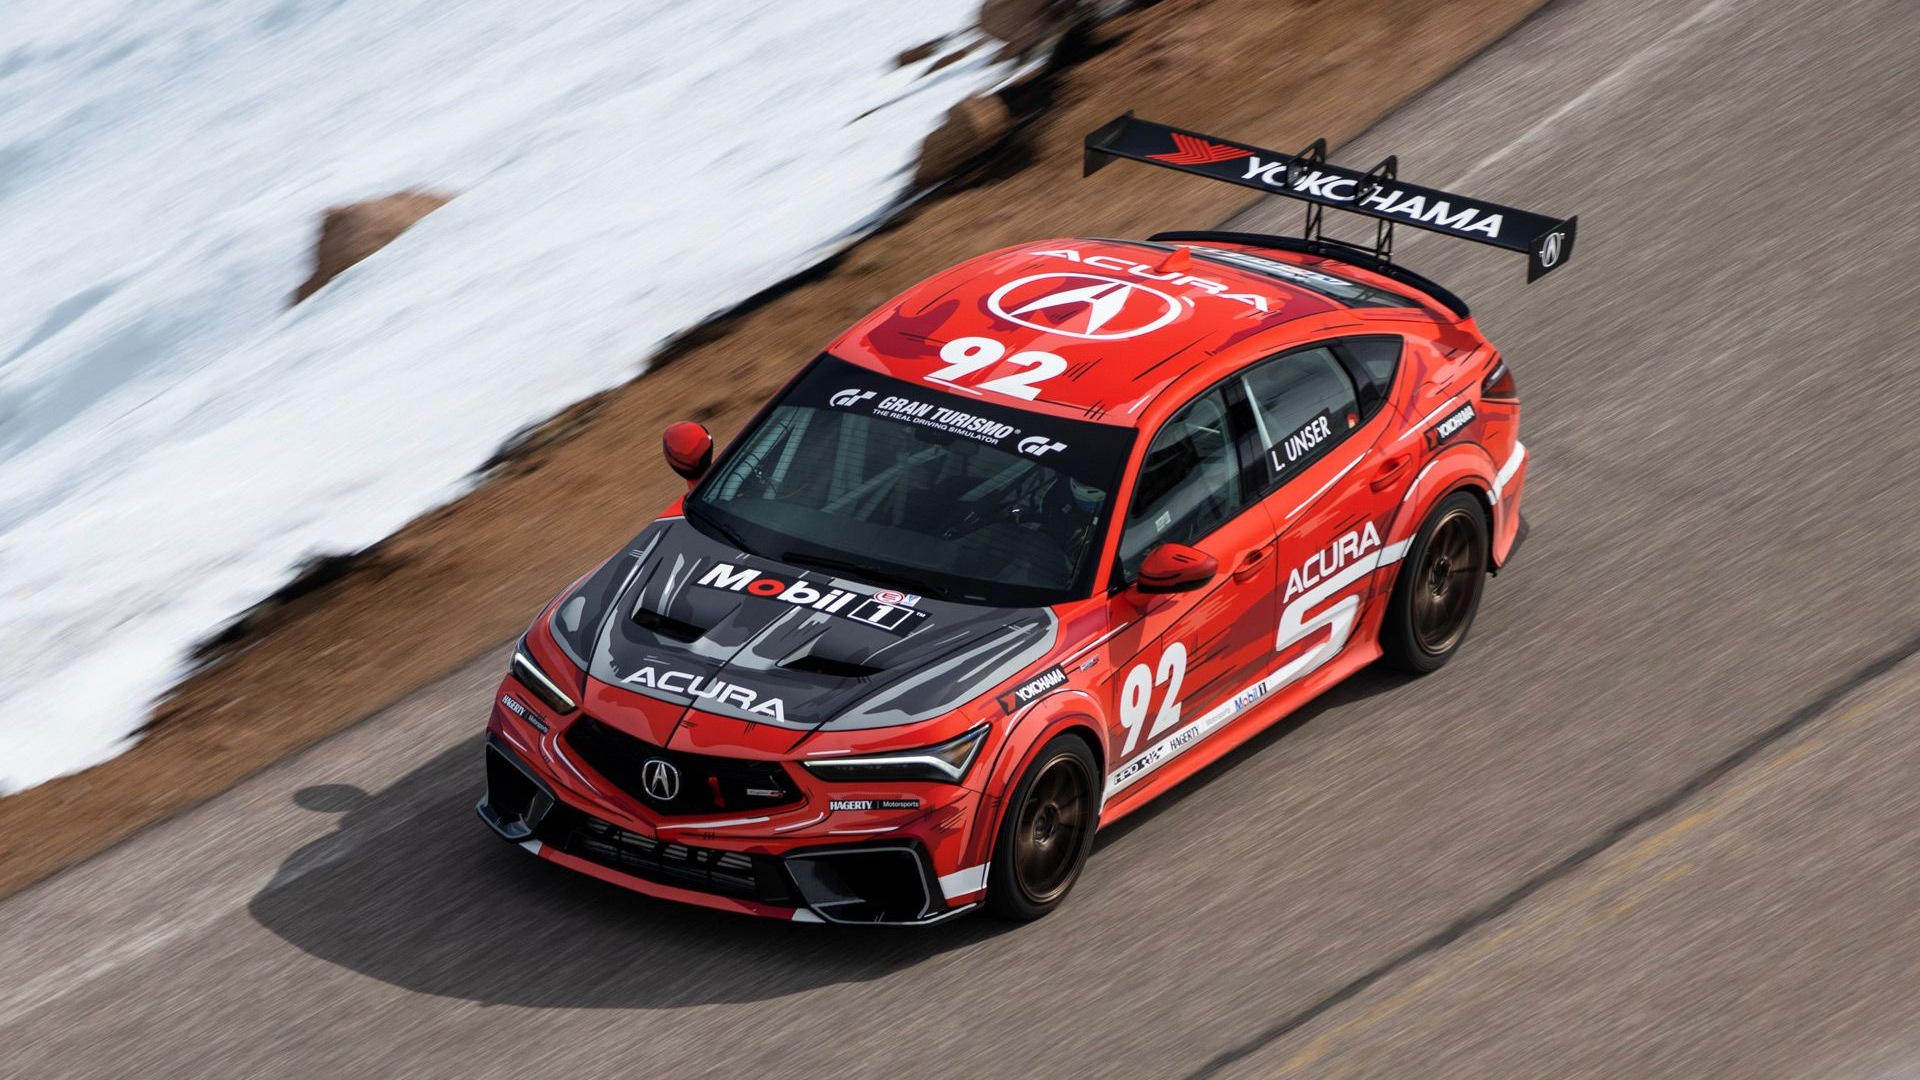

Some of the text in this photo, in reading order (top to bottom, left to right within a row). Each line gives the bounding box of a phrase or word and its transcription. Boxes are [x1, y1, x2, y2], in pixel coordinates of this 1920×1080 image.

[1029, 249, 1268, 312] ACURA
[927, 337, 1068, 401] 92
[872, 409, 999, 445] THE REAL DRIVING SIMULATOR
[878, 396, 934, 417] GRAN
[1272, 416, 1331, 471] L. UNSER
[697, 563, 857, 613] Mobil
[1283, 521, 1381, 603] ACURA
[502, 695, 525, 716] HAGERTY
[621, 666, 785, 722] ACURA
[1015, 668, 1066, 701] YOKOHAMA
[1120, 641, 1187, 758] 92
[1169, 726, 1200, 751] HAGERTY
[1234, 687, 1258, 711] Mobil
[830, 800, 919, 810] HAGERTY Motorsports
